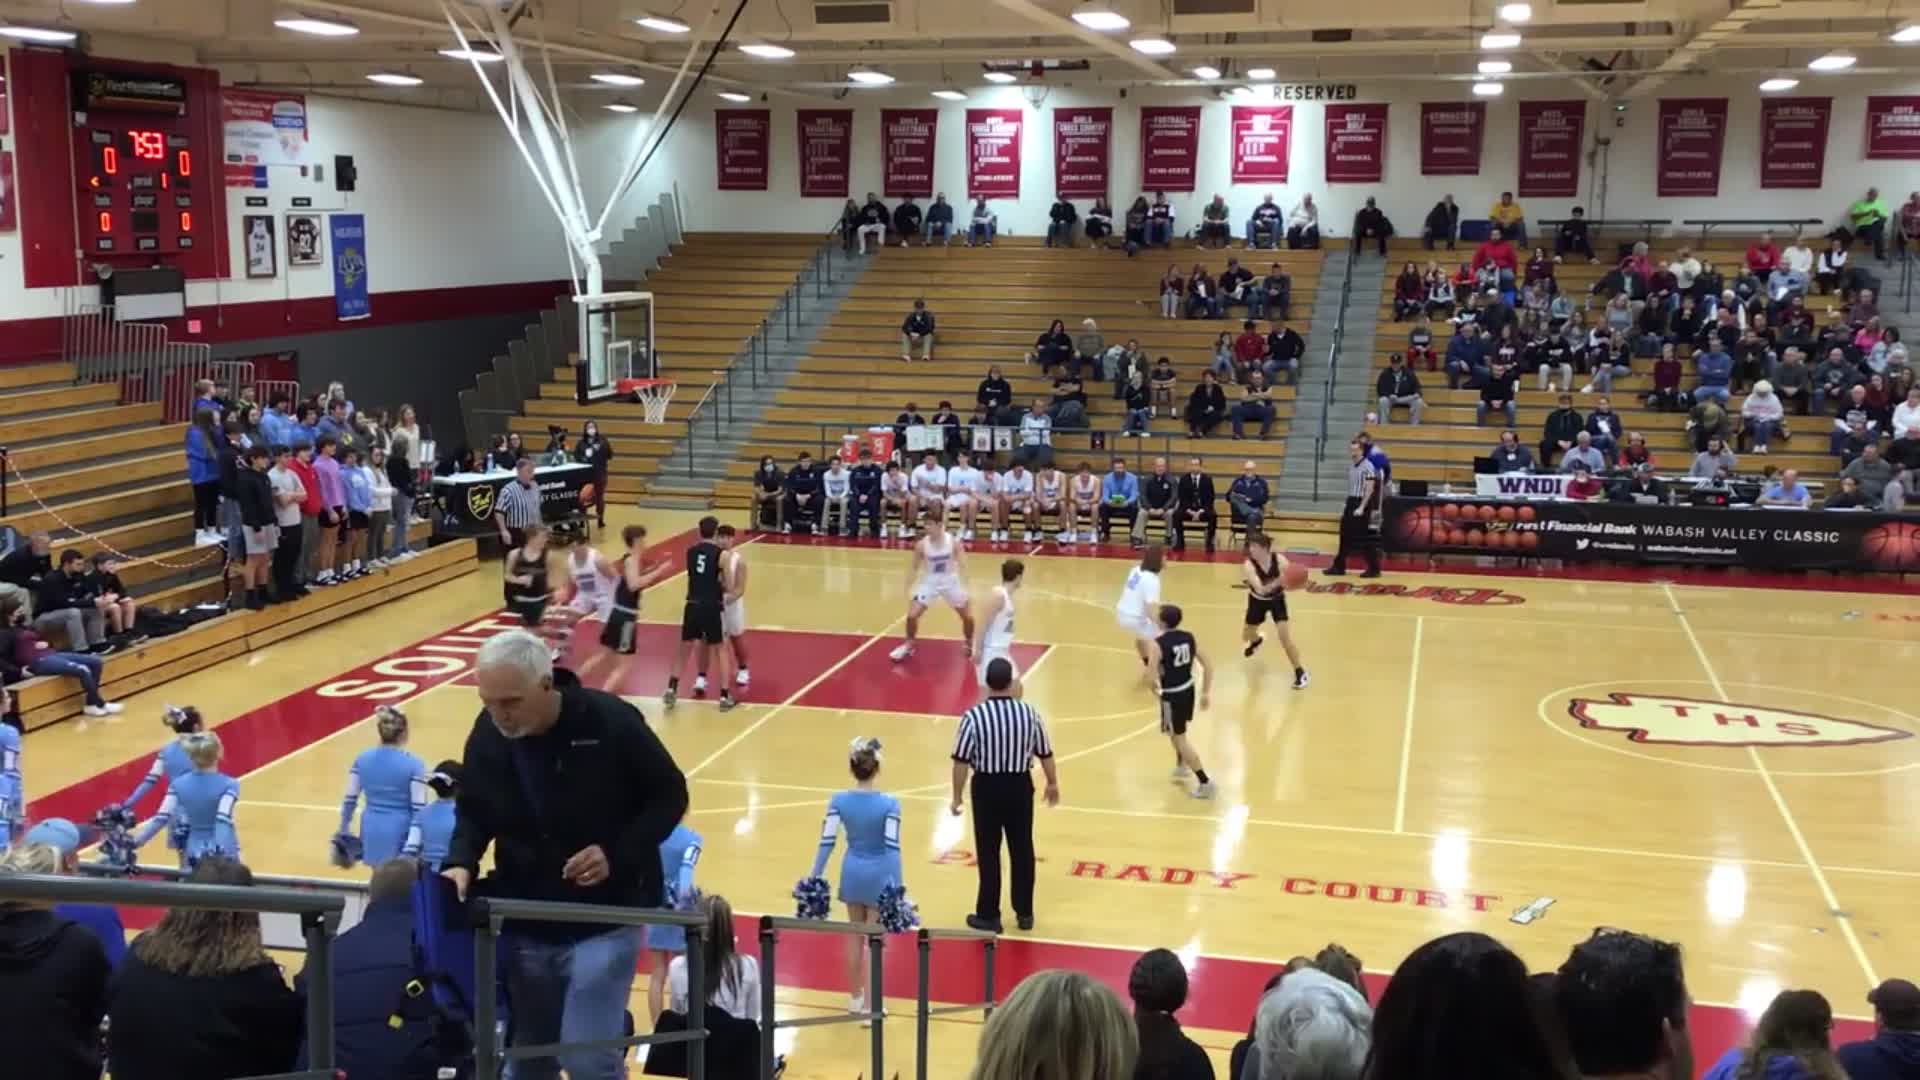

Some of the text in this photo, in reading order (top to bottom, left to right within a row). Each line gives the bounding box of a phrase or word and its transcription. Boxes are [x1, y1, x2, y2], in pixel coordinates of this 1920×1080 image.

[1273, 85, 1357, 100] RESERVED
[128, 130, 164, 159] 7:53
[104, 147, 117, 174] 0
[179, 150, 191, 176] 0
[1499, 477, 1562, 494] WNDI
[1547, 520, 1603, 533] Financial
[1604, 523, 1638, 535] Bank
[1642, 524, 1705, 538] WABASH
[1712, 528, 1767, 540] VALLEY
[1773, 530, 1840, 543] CLASSIC
[697, 554, 706, 573] 5
[1172, 643, 1190, 667] 20
[1070, 860, 1503, 912] RADY COURT
